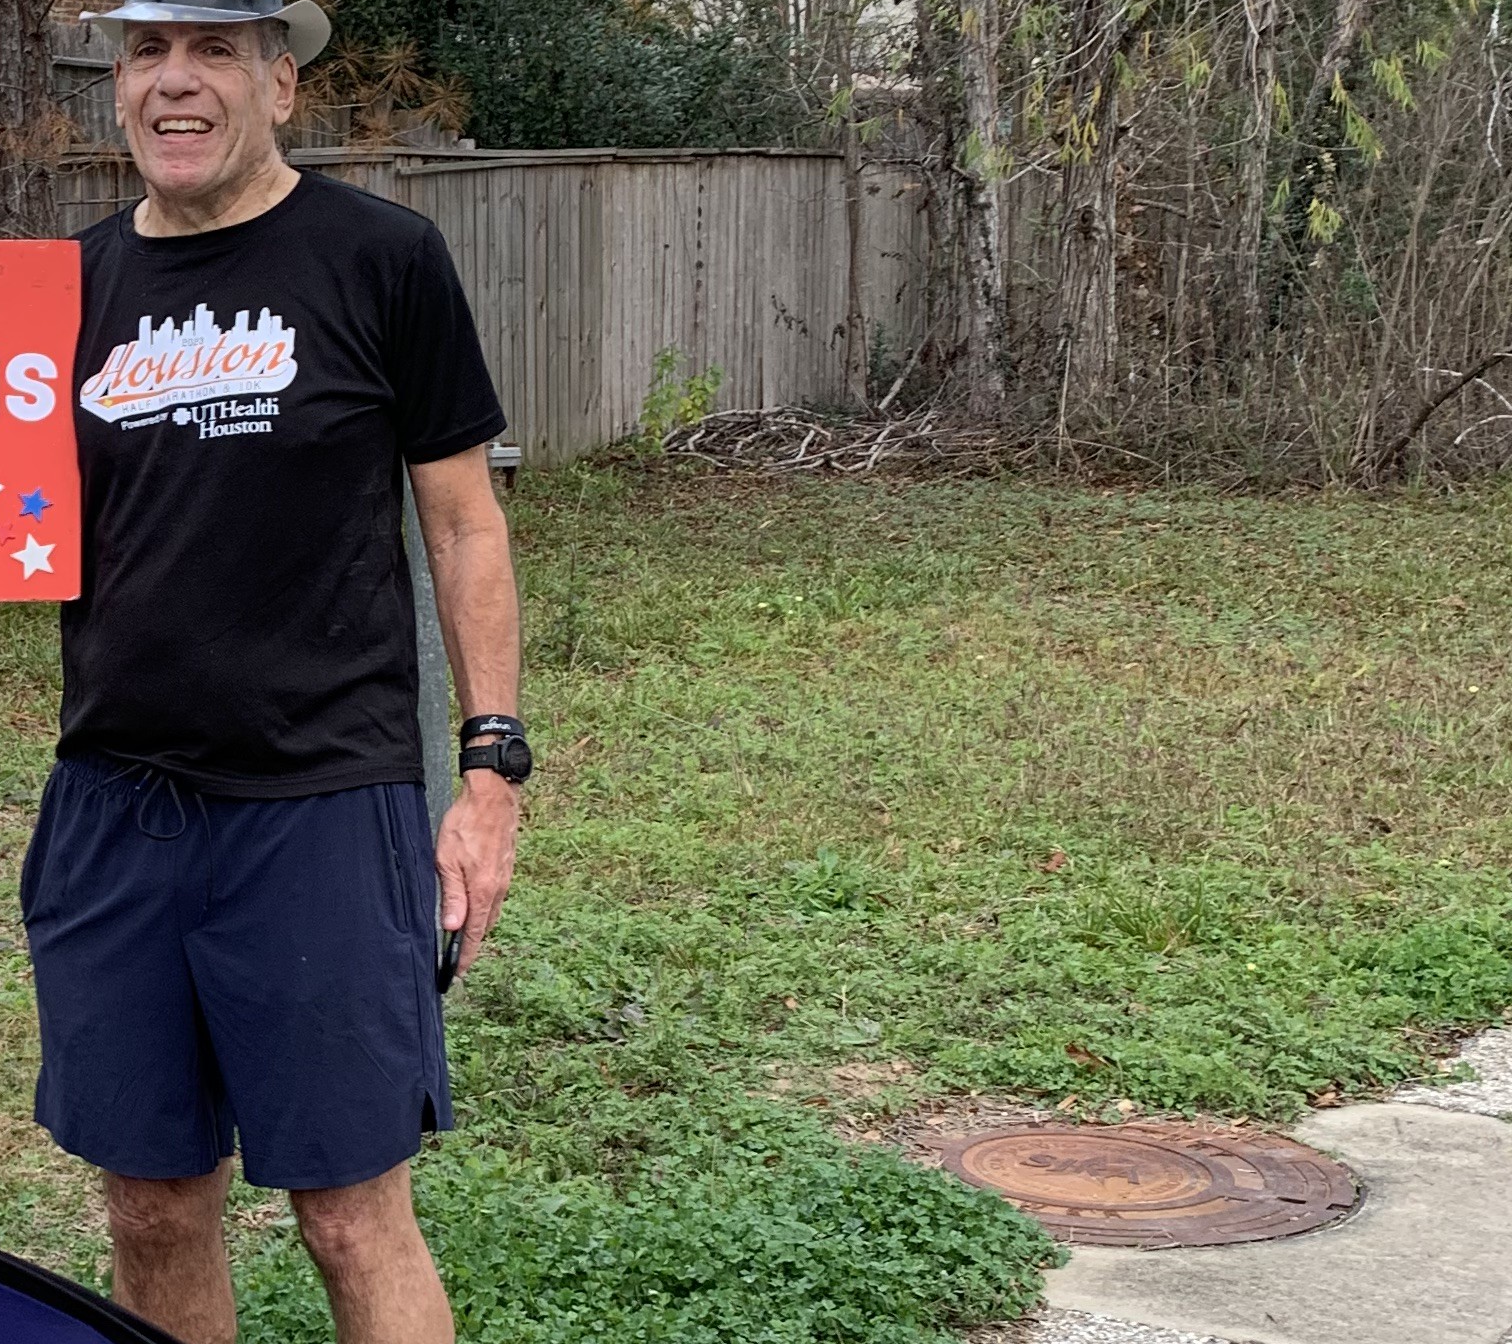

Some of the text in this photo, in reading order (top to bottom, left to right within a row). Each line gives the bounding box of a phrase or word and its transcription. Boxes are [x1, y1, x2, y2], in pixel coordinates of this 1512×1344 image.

[81, 334, 290, 396] Houston
[121, 400, 151, 415] HALF
[158, 385, 217, 405] MARATHON
[238, 380, 263, 393] 10K
[198, 419, 273, 440] Houston
